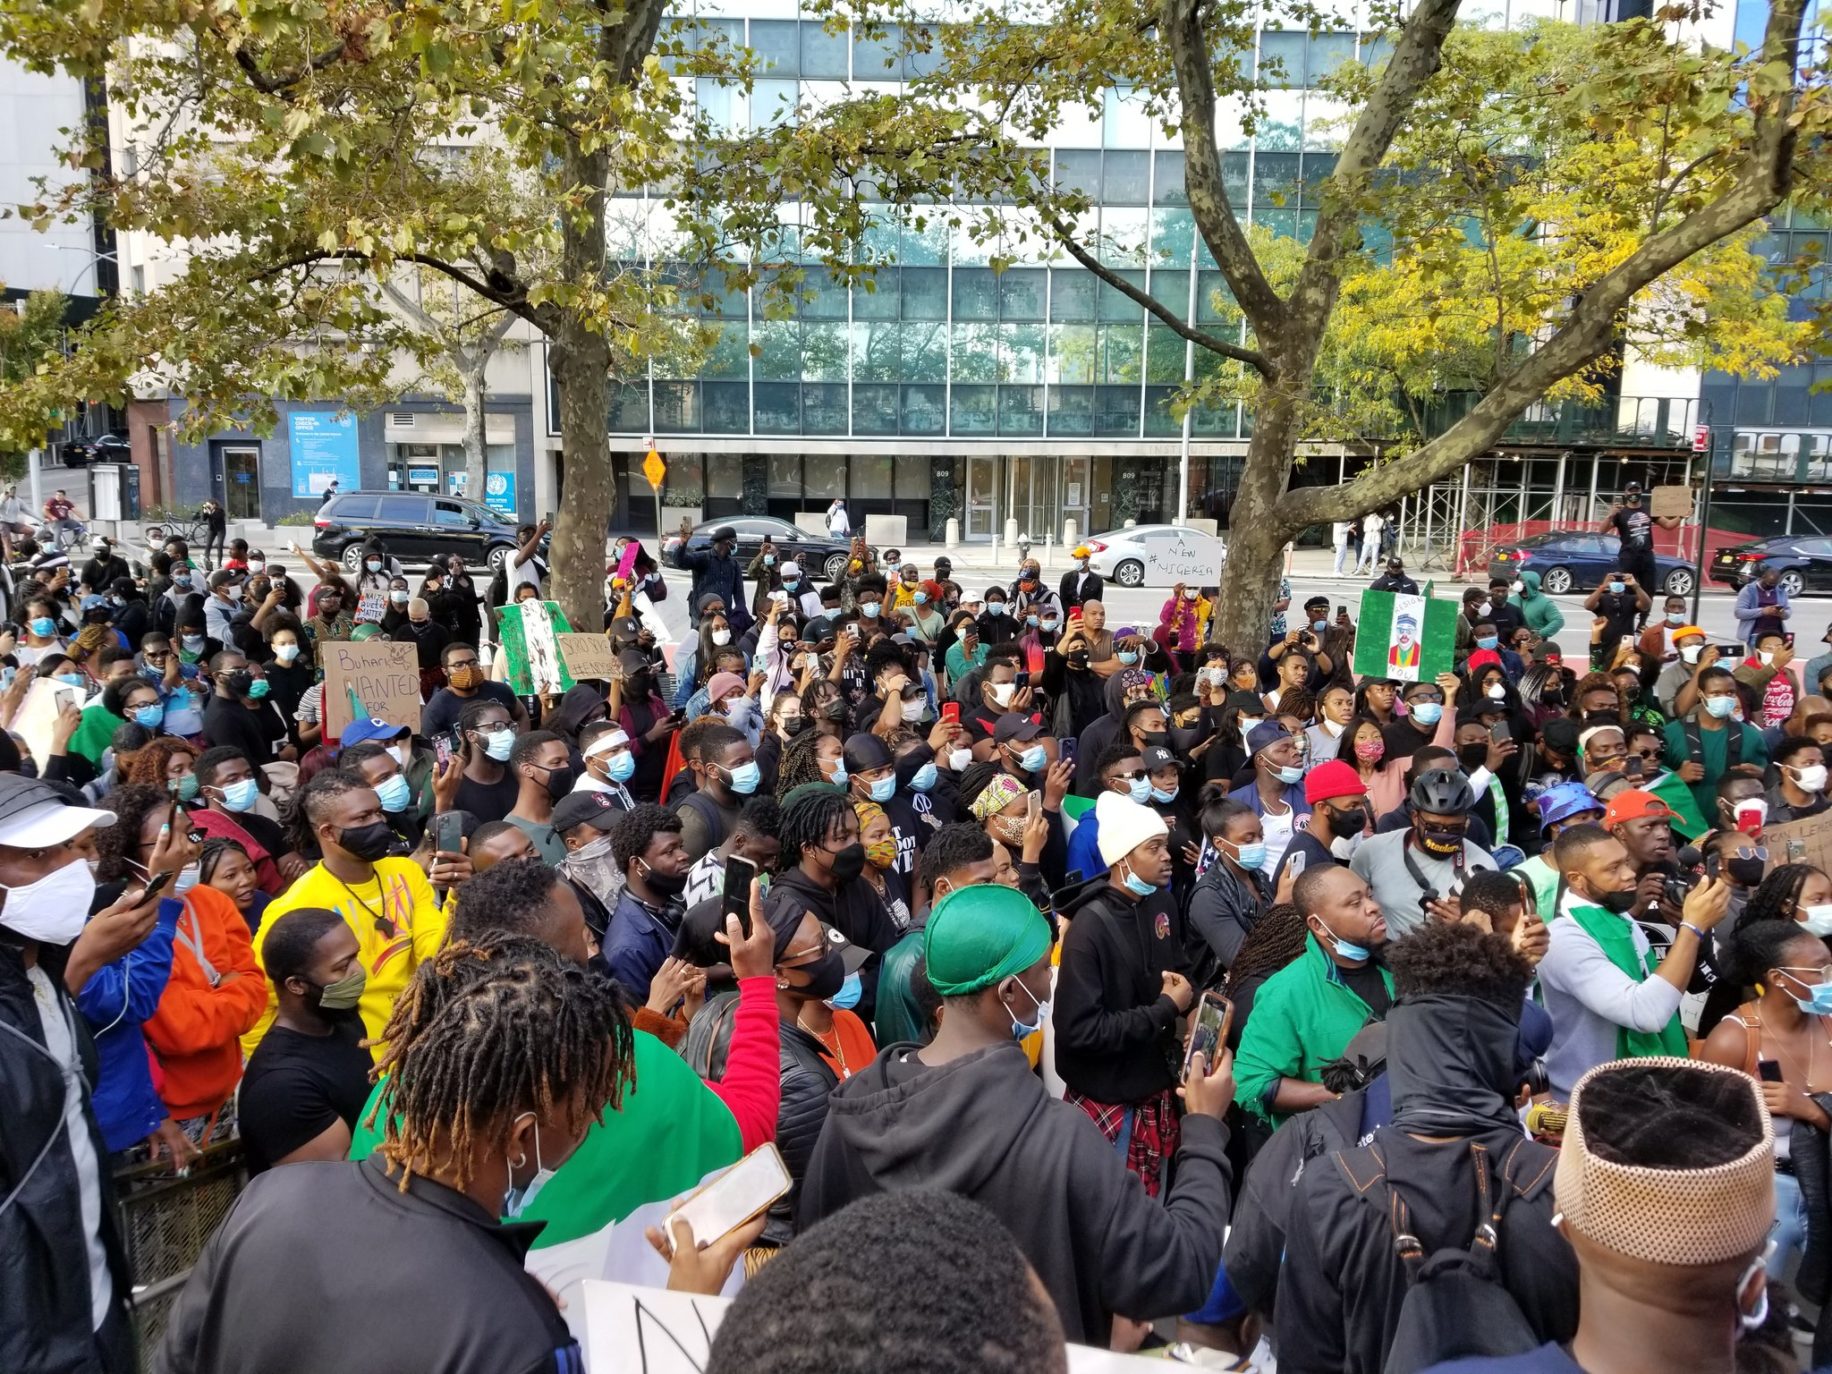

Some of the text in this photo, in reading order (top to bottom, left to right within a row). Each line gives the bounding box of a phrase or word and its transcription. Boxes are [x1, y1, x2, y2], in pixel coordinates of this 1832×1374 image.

[1177, 538, 1186, 547] A
[1168, 547, 1196, 558] NEW
[1157, 563, 1213, 576] NIGERIA
[365, 702, 390, 712] FOR
